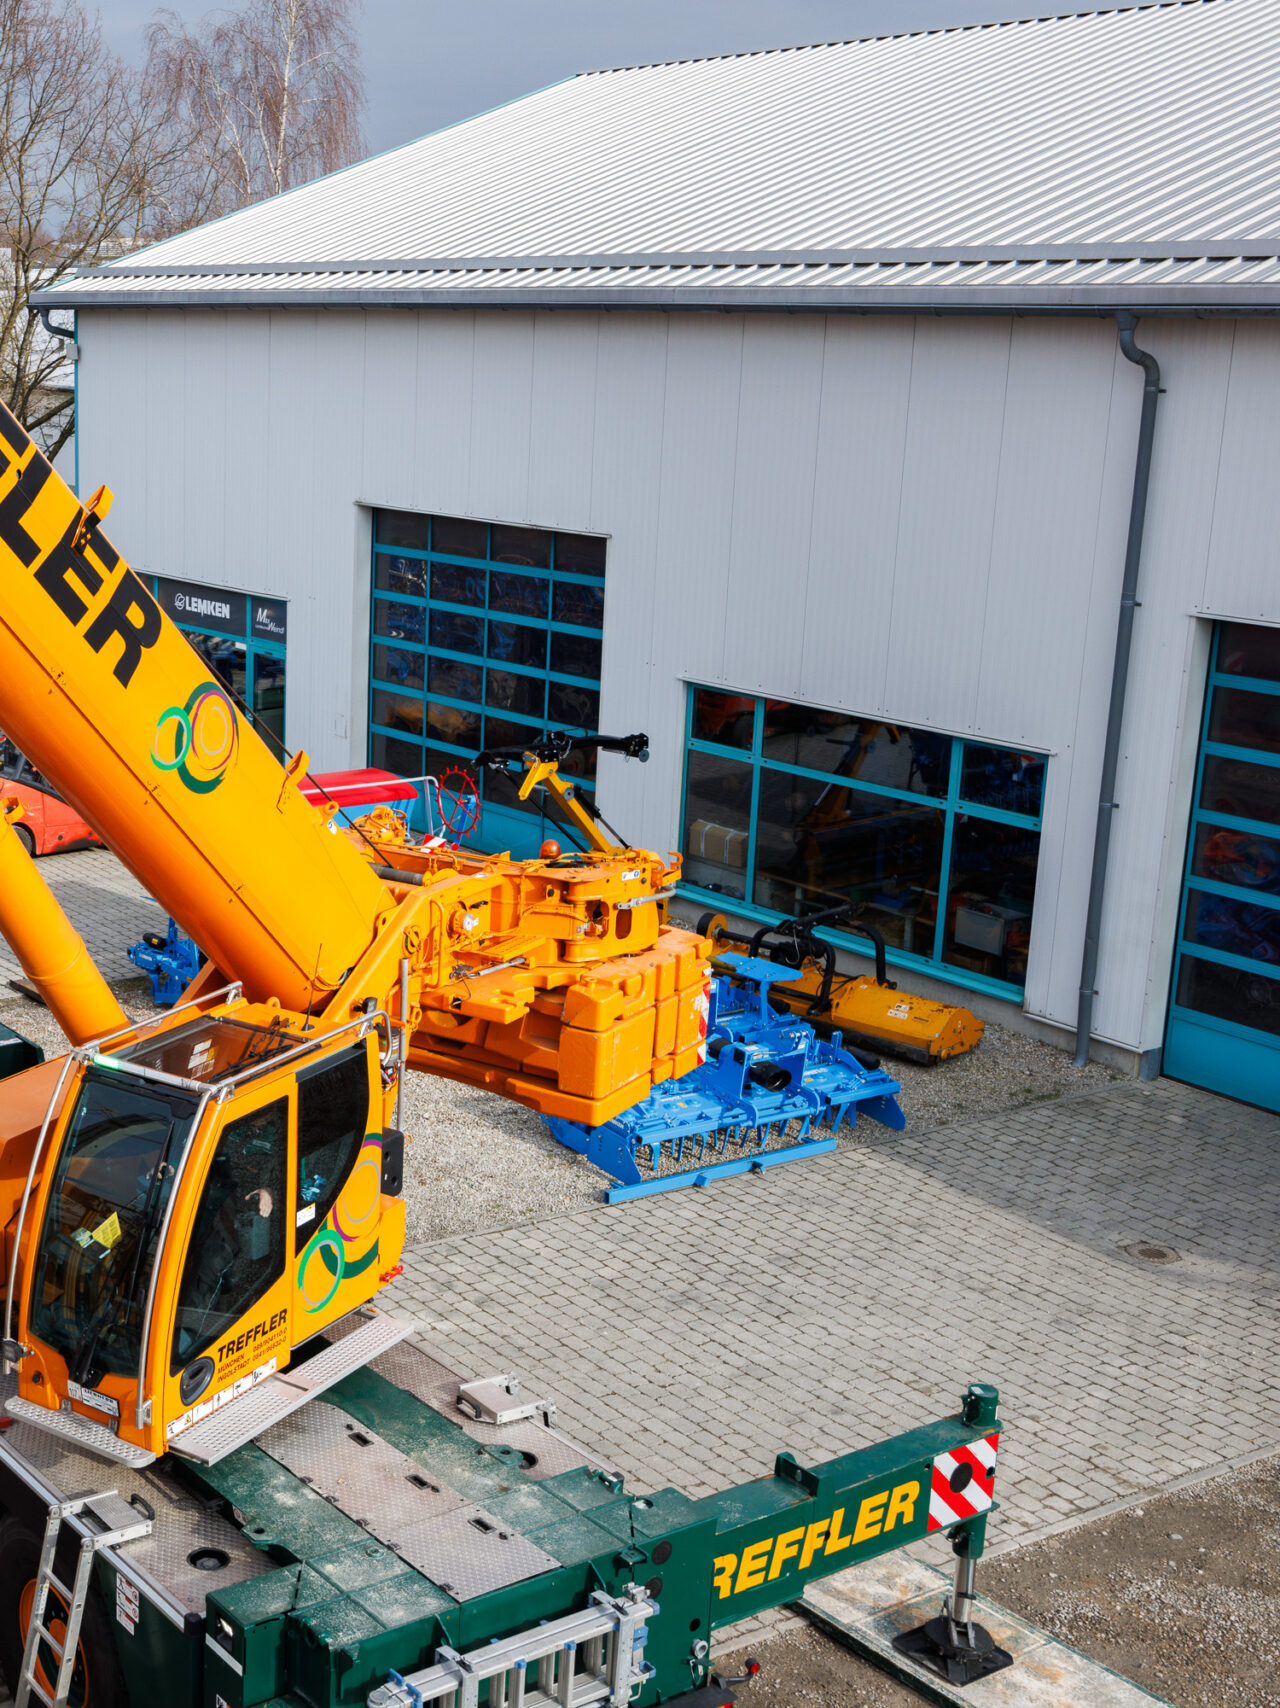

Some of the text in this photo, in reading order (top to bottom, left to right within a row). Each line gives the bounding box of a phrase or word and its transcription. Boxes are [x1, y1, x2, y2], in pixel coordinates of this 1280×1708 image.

[185, 595, 231, 619] LEMKEN
[217, 1308, 288, 1363] TREFFLER
[218, 1353, 245, 1374] MÜNCHEN
[218, 1358, 251, 1383] INGOLSTADT
[713, 1480, 921, 1600] REFFLER
